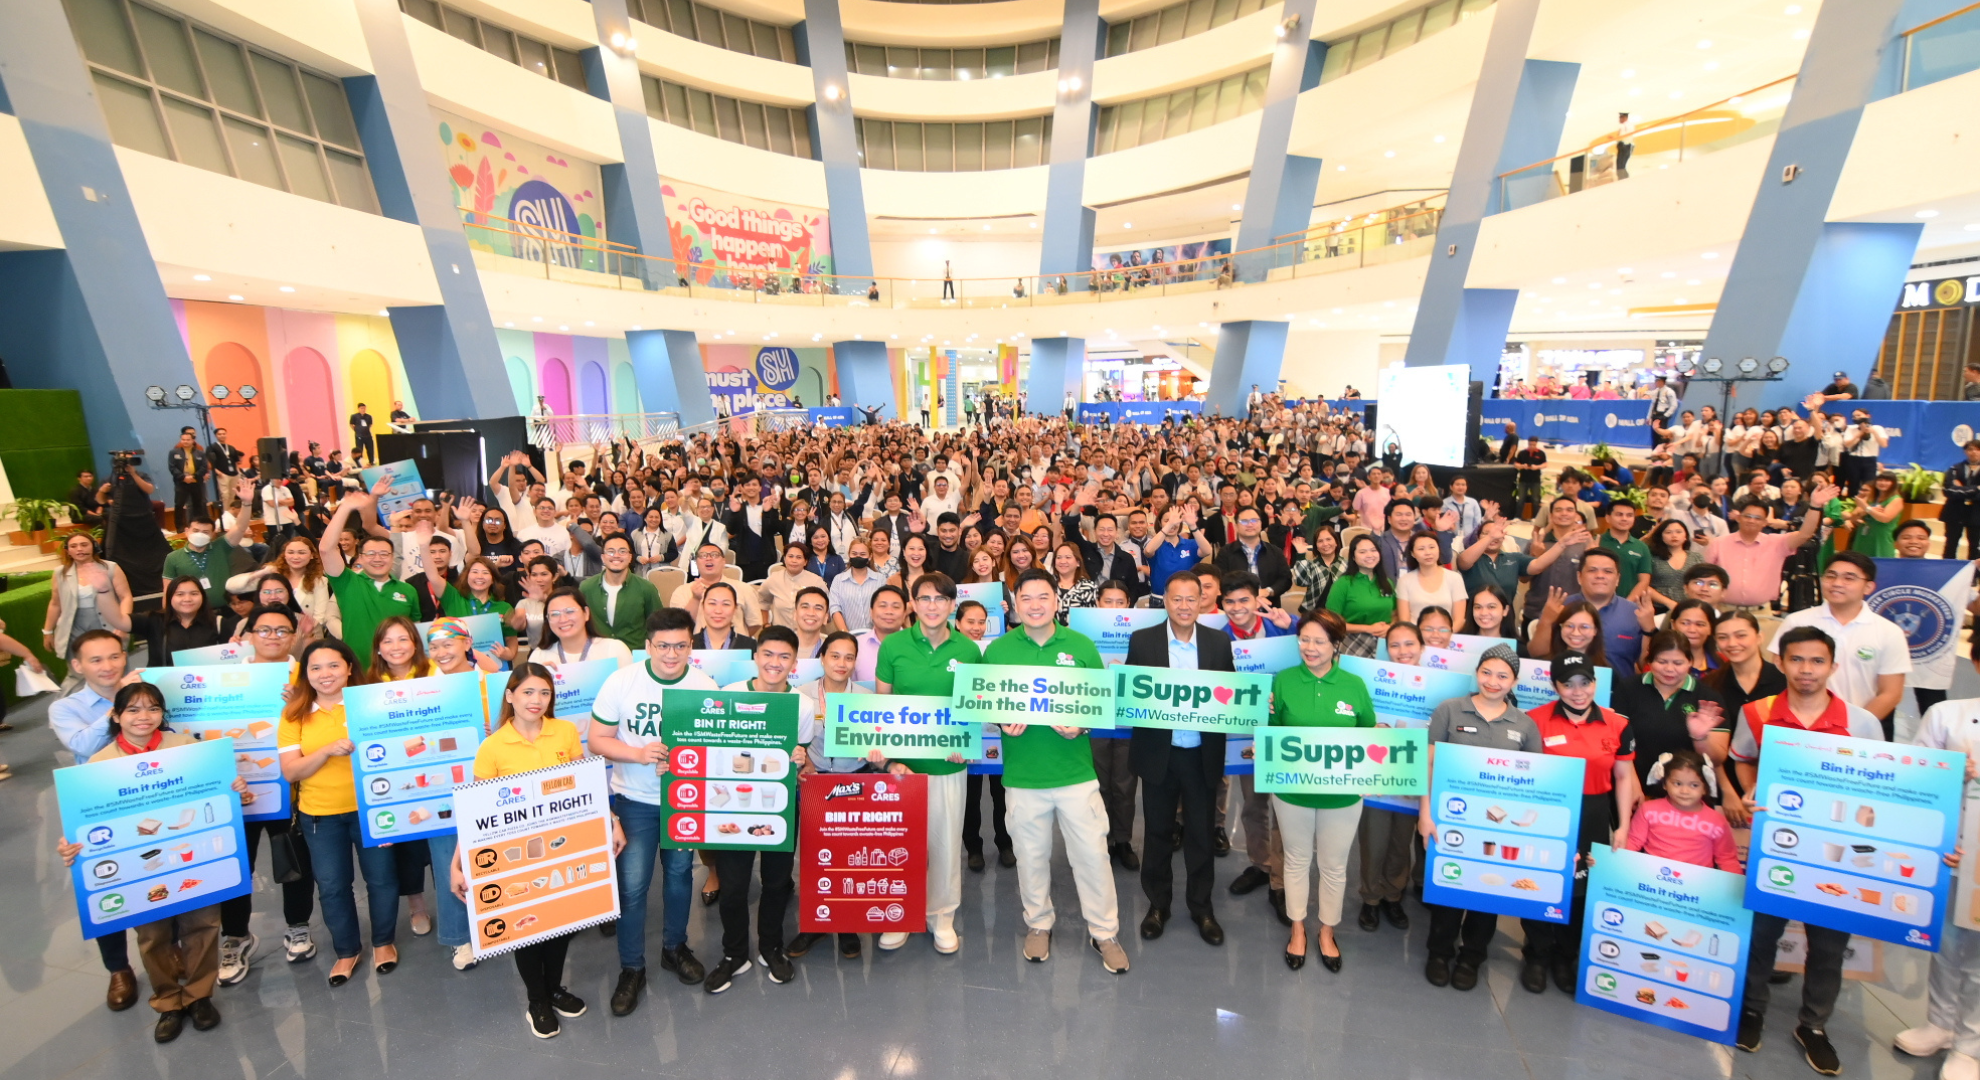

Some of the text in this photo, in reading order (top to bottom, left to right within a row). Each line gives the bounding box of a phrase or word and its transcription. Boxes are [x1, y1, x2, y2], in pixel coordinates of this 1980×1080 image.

[690, 198, 803, 241] Good things
[711, 227, 783, 259] happen
[1882, 589, 1911, 598] CIRCLE
[1236, 663, 1265, 672] it right!
[1427, 662, 1448, 670] CARES
[1564, 656, 1583, 665] KFC
[971, 677, 1112, 698] Be the Solution
[1117, 673, 1126, 698] I
[1374, 676, 1396, 685] CARES
[556, 689, 580, 699] right!
[1375, 688, 1426, 703] Bin it right!
[1517, 684, 1539, 694] Bin it
[184, 693, 244, 704] Bin it right!
[383, 697, 407, 706] CARES
[955, 695, 1103, 716] Join the Mission
[388, 705, 441, 720] Bin it right!
[700, 707, 725, 715] CARES
[838, 704, 969, 726] I care for th
[1116, 706, 1259, 728] #SMWasteFreeFuture
[694, 719, 766, 730] BIN IT RIGHT!
[835, 726, 972, 748] Environment
[1264, 736, 1273, 761] I
[1486, 758, 1510, 767] KFC
[135, 768, 163, 778] CARES
[1479, 771, 1535, 786] Bin it right!
[1820, 761, 1895, 782] Bin it right!
[118, 776, 183, 797] Bin it right!
[1264, 772, 1417, 788] #SMWasteFreeFuture
[825, 782, 861, 800] Max's
[871, 793, 900, 801] CARES
[496, 794, 526, 808] CARES
[476, 793, 593, 831] WE BIN IT RIGHT!
[825, 811, 903, 823] BIN IT RIGHT!
[1645, 811, 1724, 839] adidas
[1656, 874, 1684, 885] CARES
[1638, 882, 1699, 903] Bin it right!
